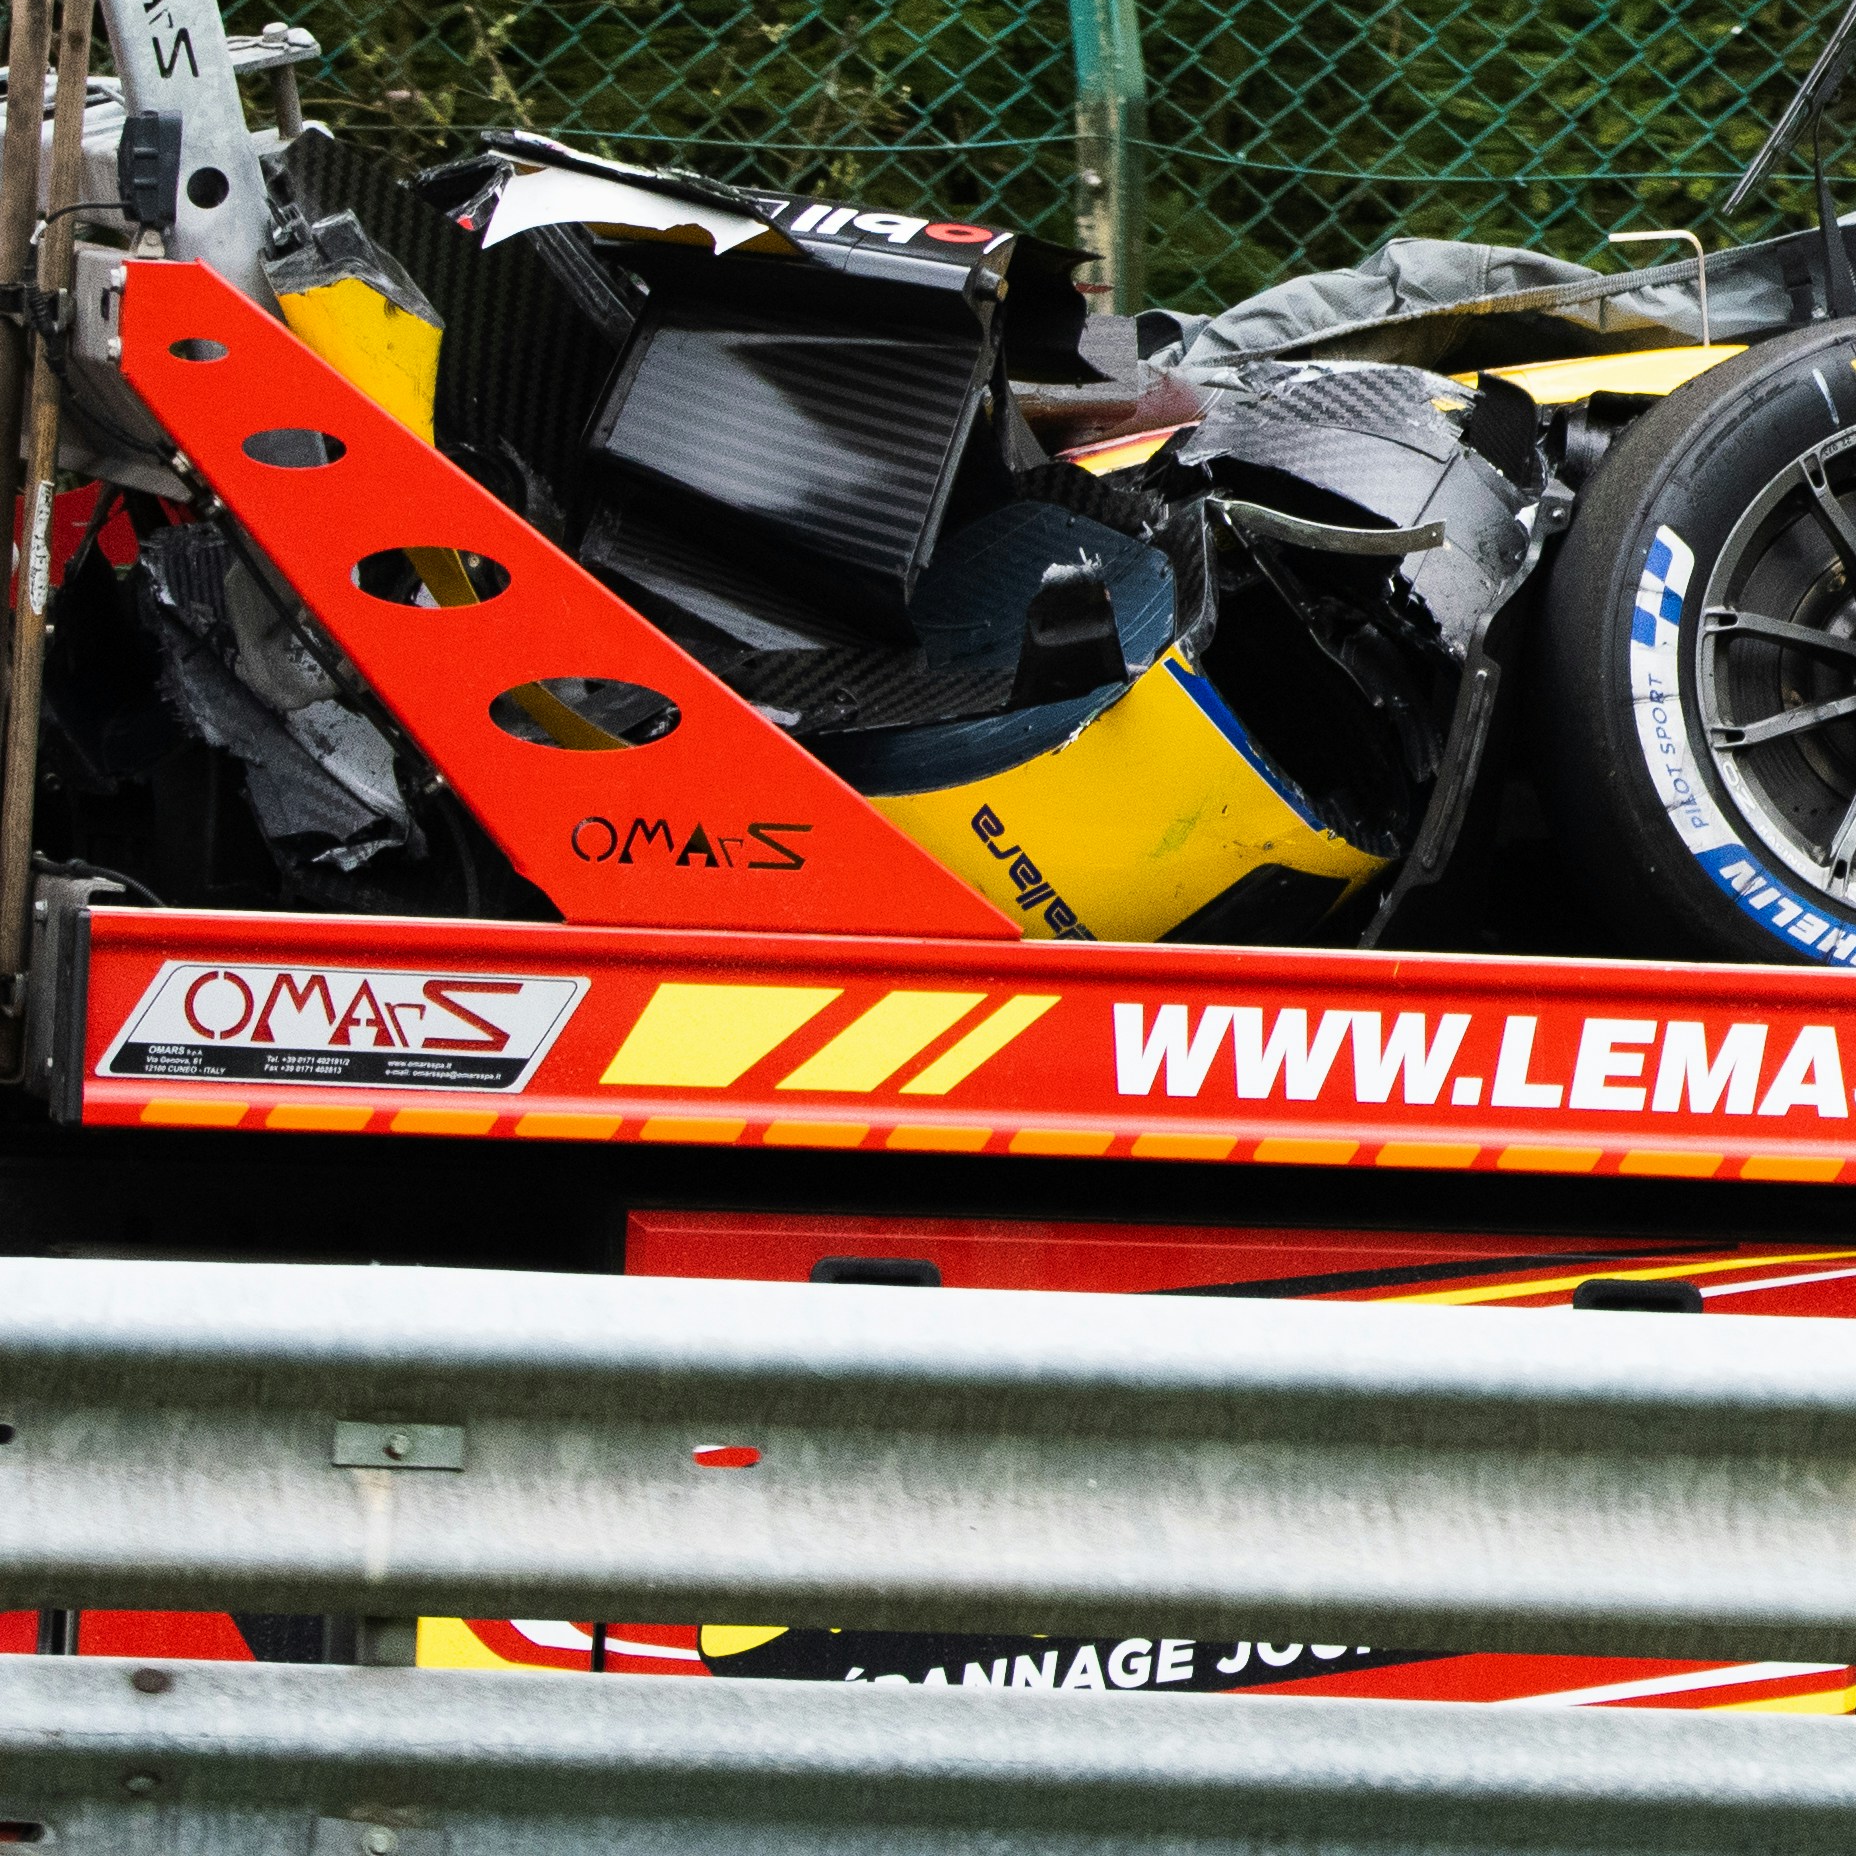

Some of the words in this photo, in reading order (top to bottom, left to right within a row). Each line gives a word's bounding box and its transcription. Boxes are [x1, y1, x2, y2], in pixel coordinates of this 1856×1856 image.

[1647, 673, 1677, 756] SPORT
[1665, 763, 1710, 829] PILOT
[148, 1045, 186, 1055] OMARS
[203, 1066, 226, 1075] ITALY
